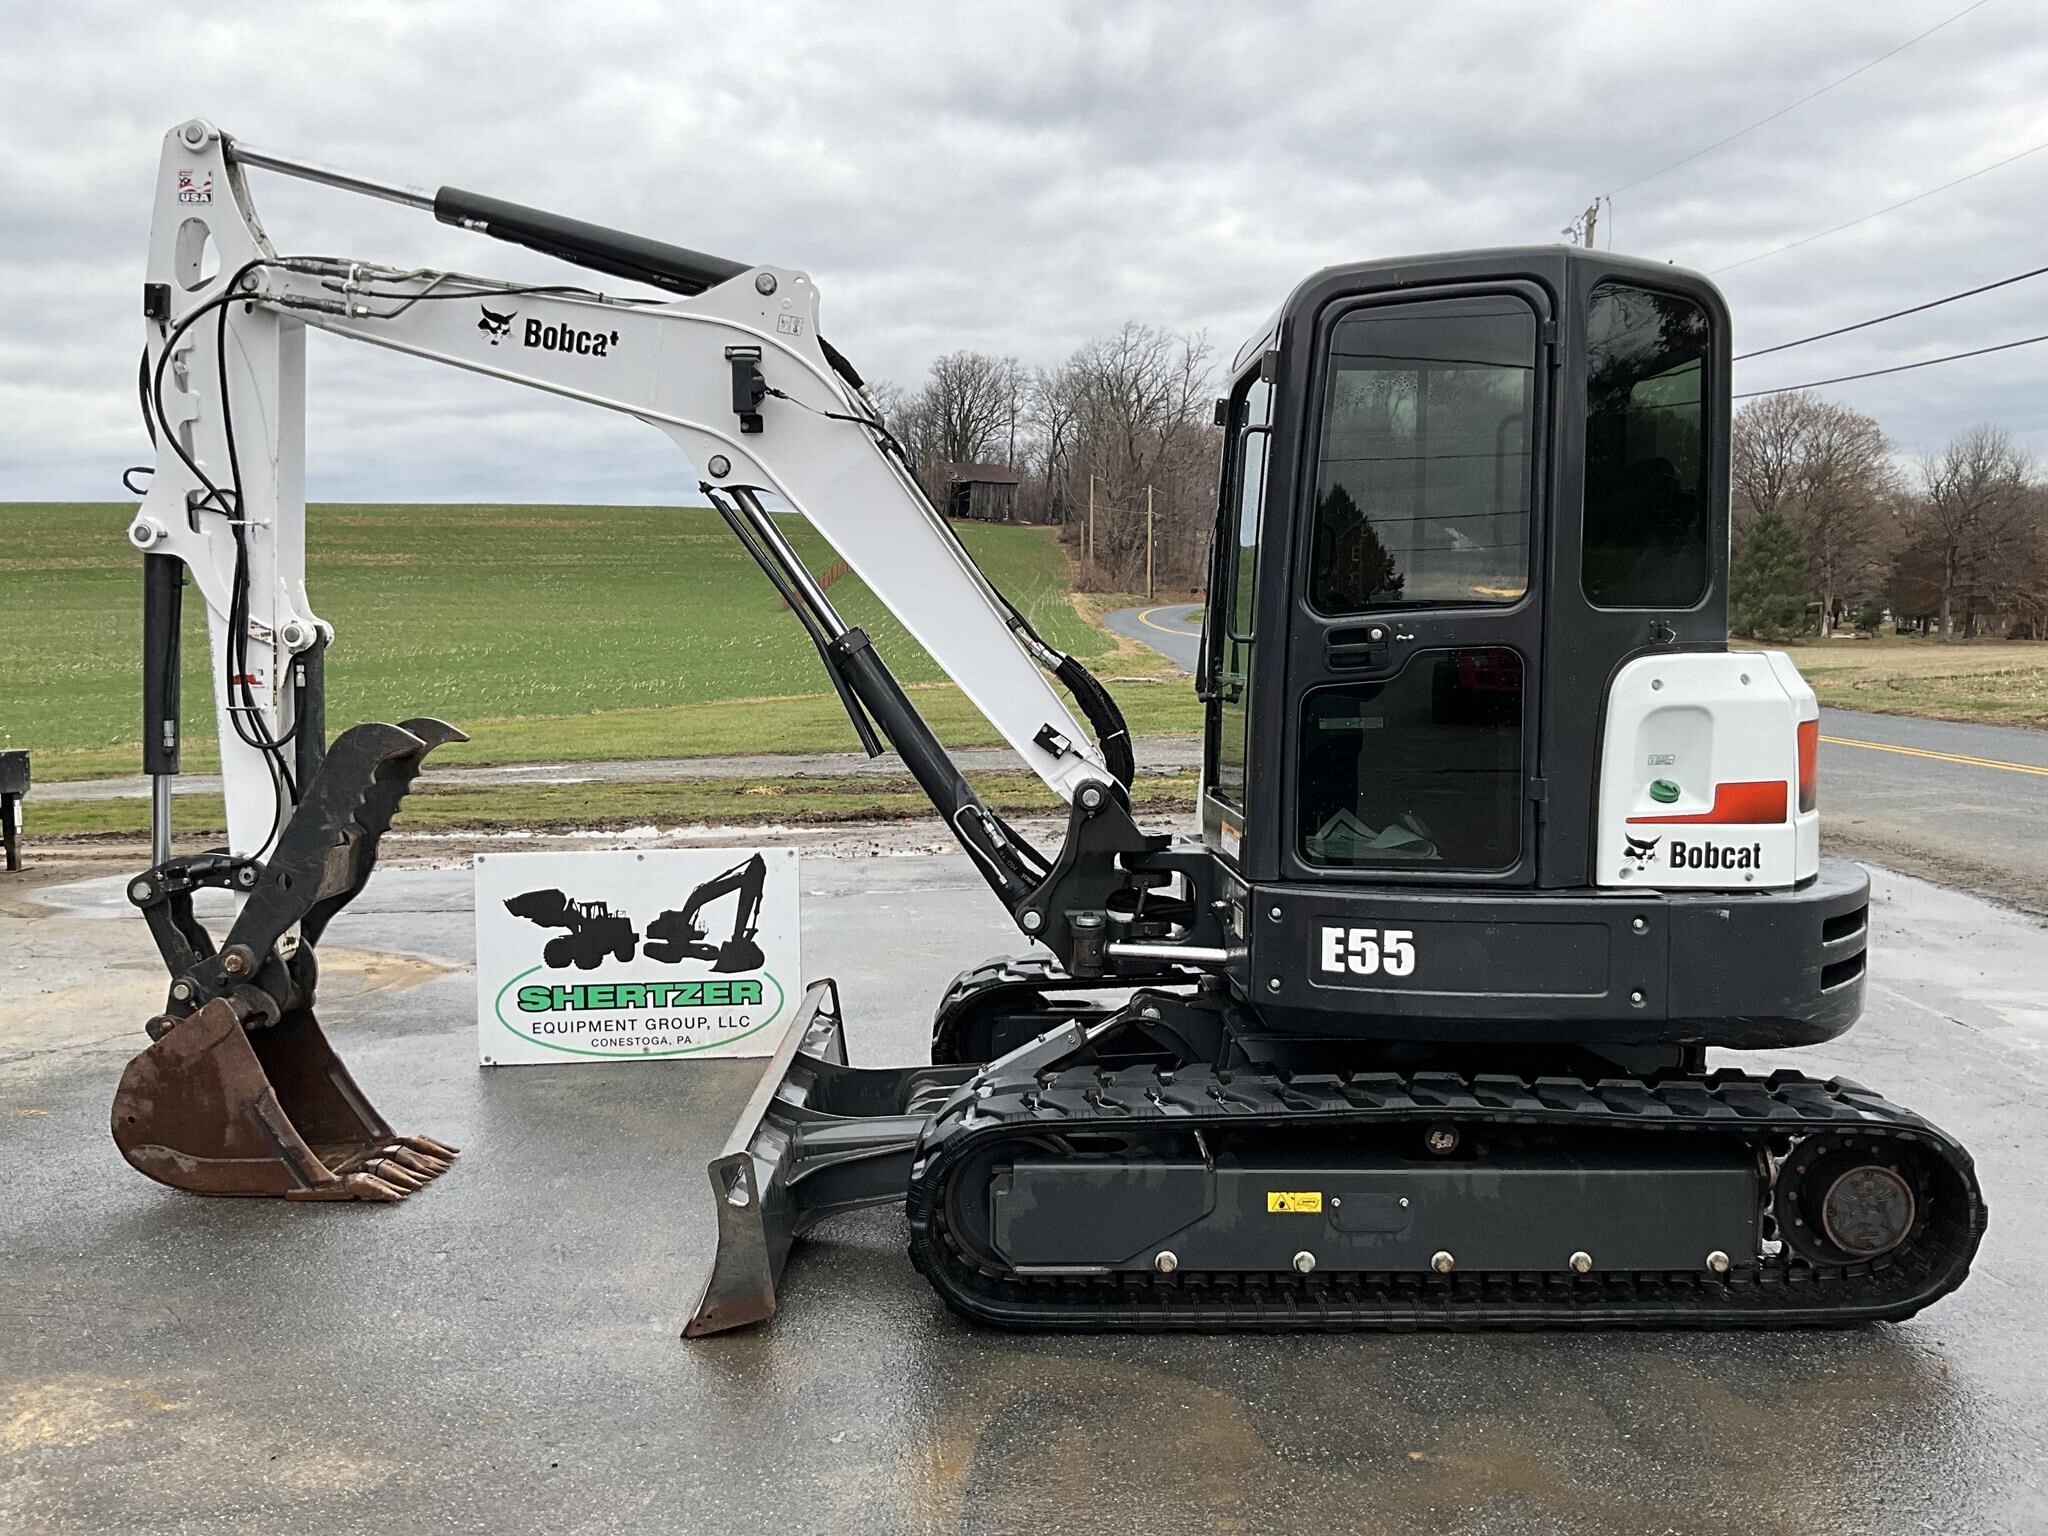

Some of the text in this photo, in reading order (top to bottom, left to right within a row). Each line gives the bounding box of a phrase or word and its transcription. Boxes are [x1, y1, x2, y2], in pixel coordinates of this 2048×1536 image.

[180, 193, 210, 202] USA
[523, 318, 619, 357] Bobcat
[1669, 841, 1761, 869] Bobcat
[1321, 926, 1415, 976] E55
[517, 980, 762, 1012] SHERTZER
[531, 1015, 751, 1035] EQUIPMENT GROUP, LLC
[591, 1035, 692, 1048] CONESTOGA, PA
